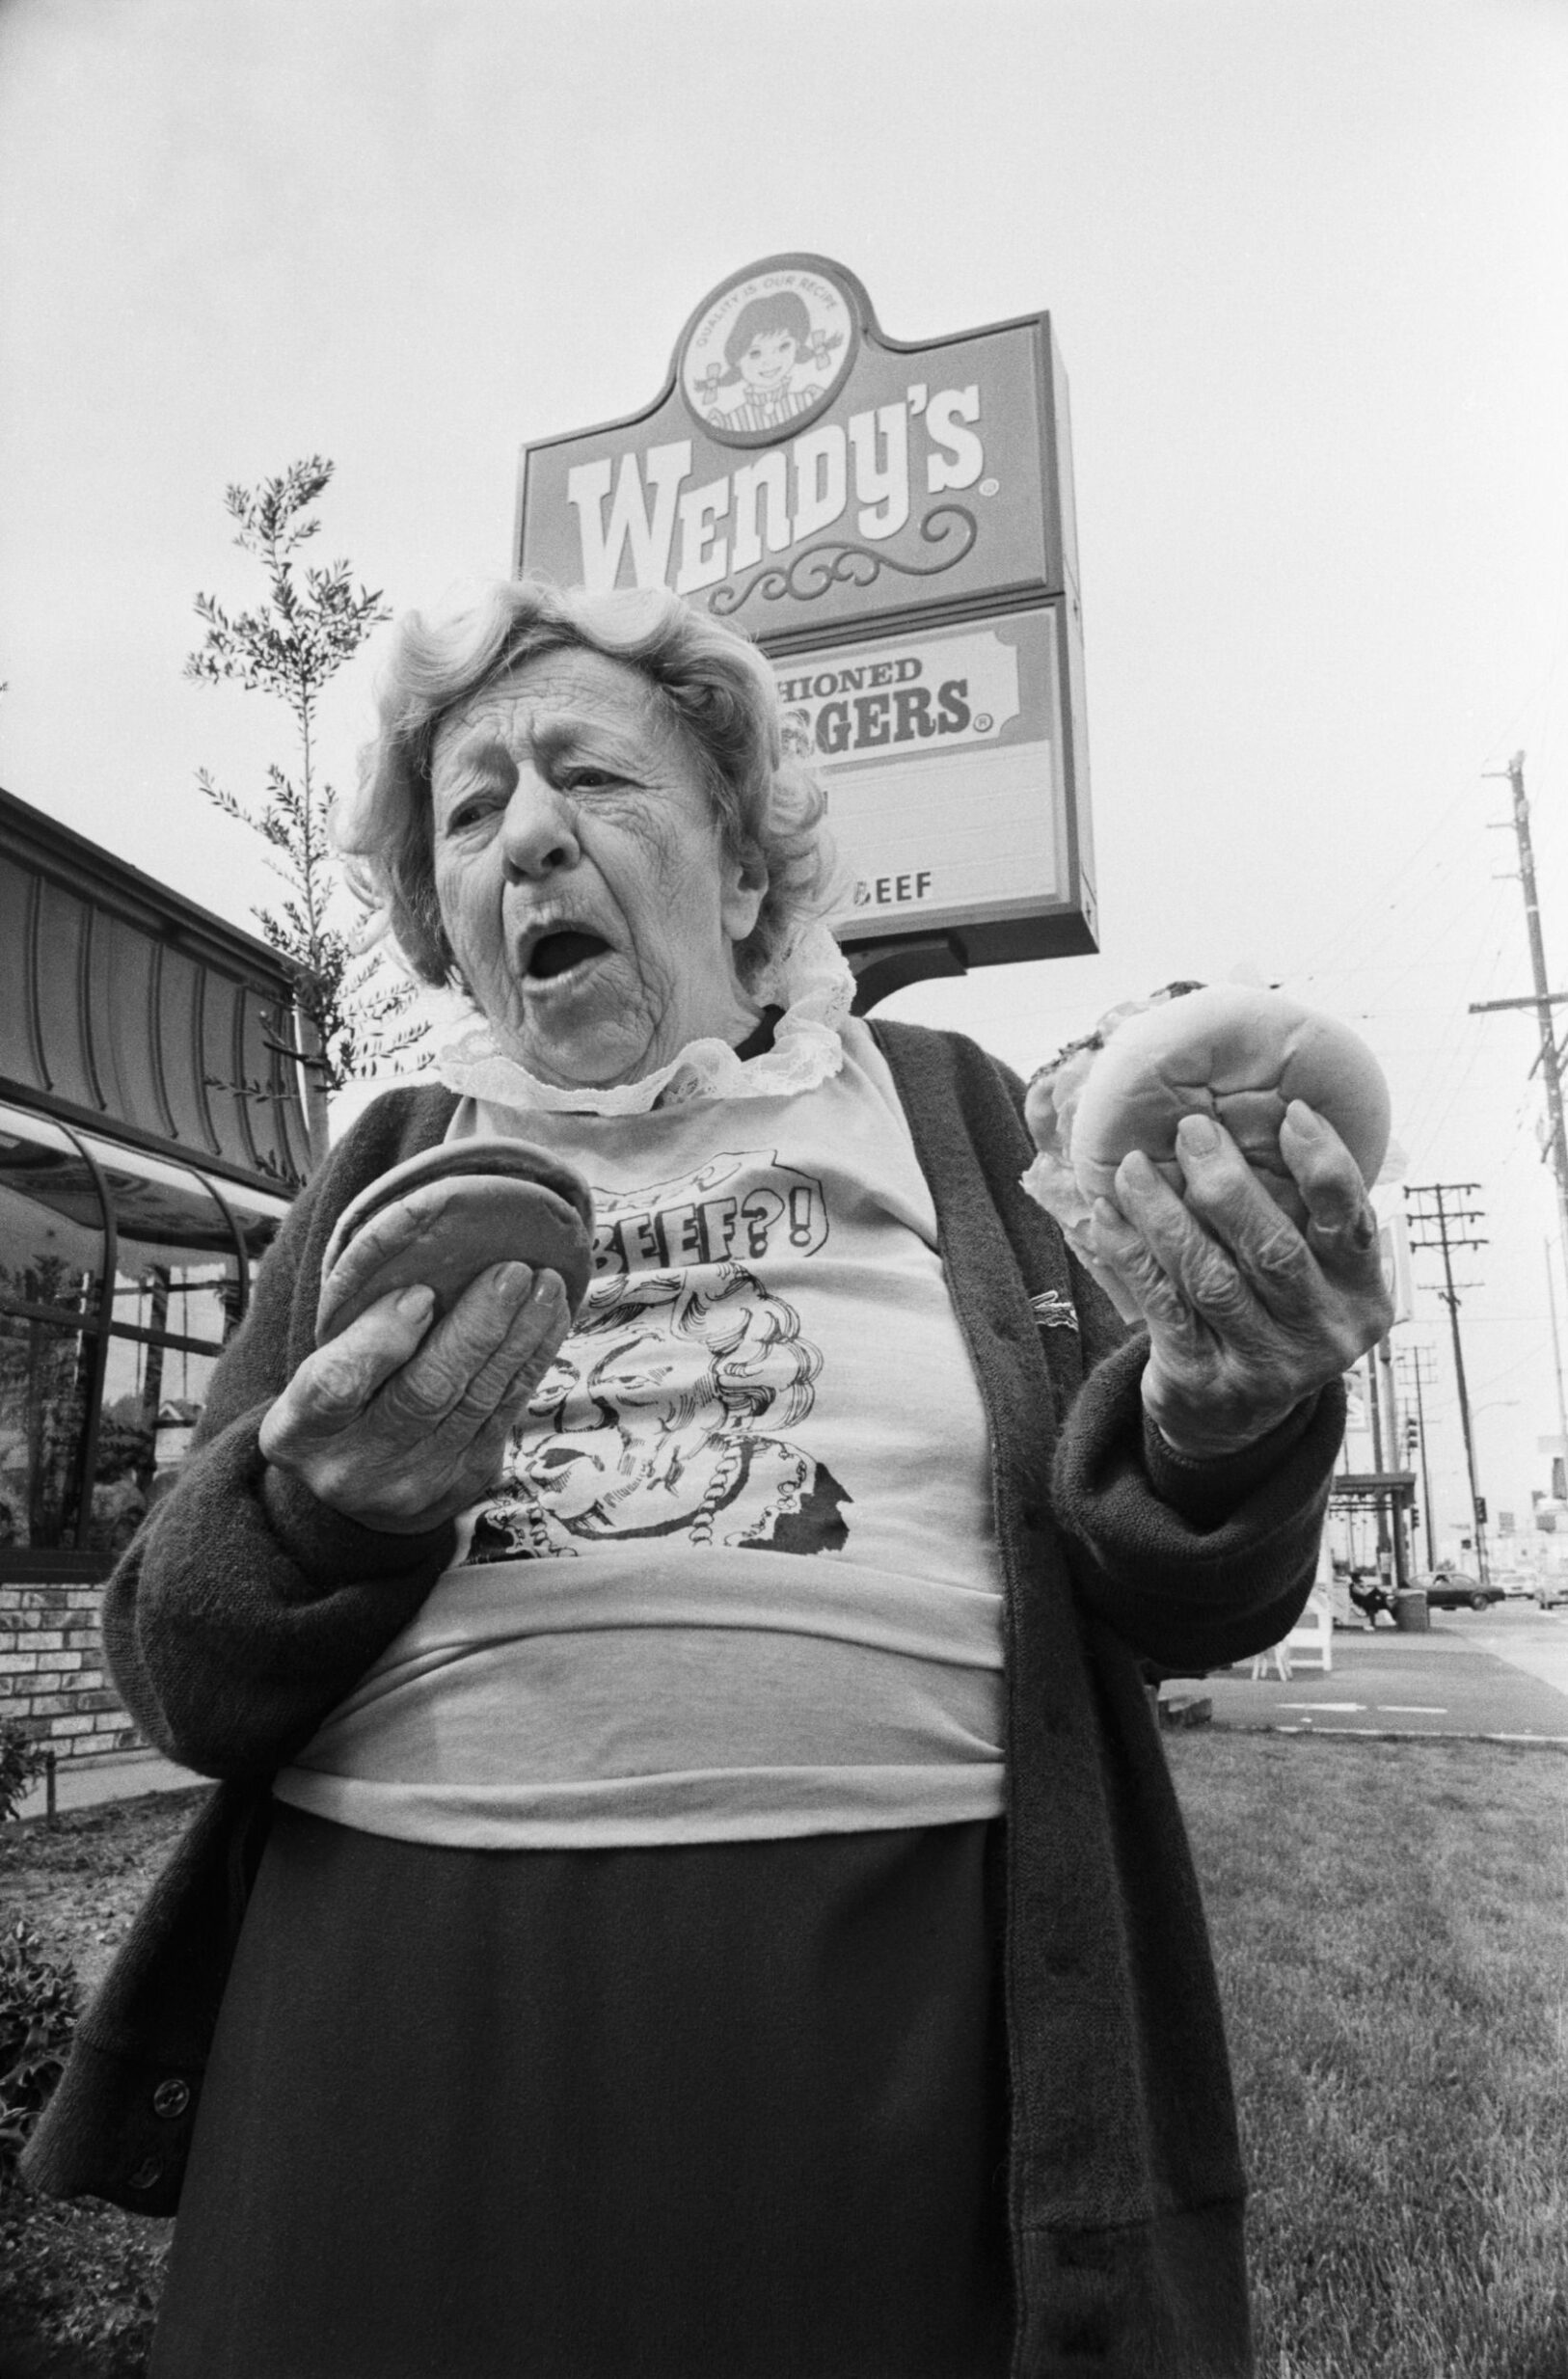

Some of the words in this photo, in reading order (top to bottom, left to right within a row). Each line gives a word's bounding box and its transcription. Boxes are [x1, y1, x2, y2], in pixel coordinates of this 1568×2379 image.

[696, 295, 740, 348] QUALITY
[743, 284, 758, 298] IS
[763, 275, 797, 289] OUR
[798, 277, 838, 312] RECIPE
